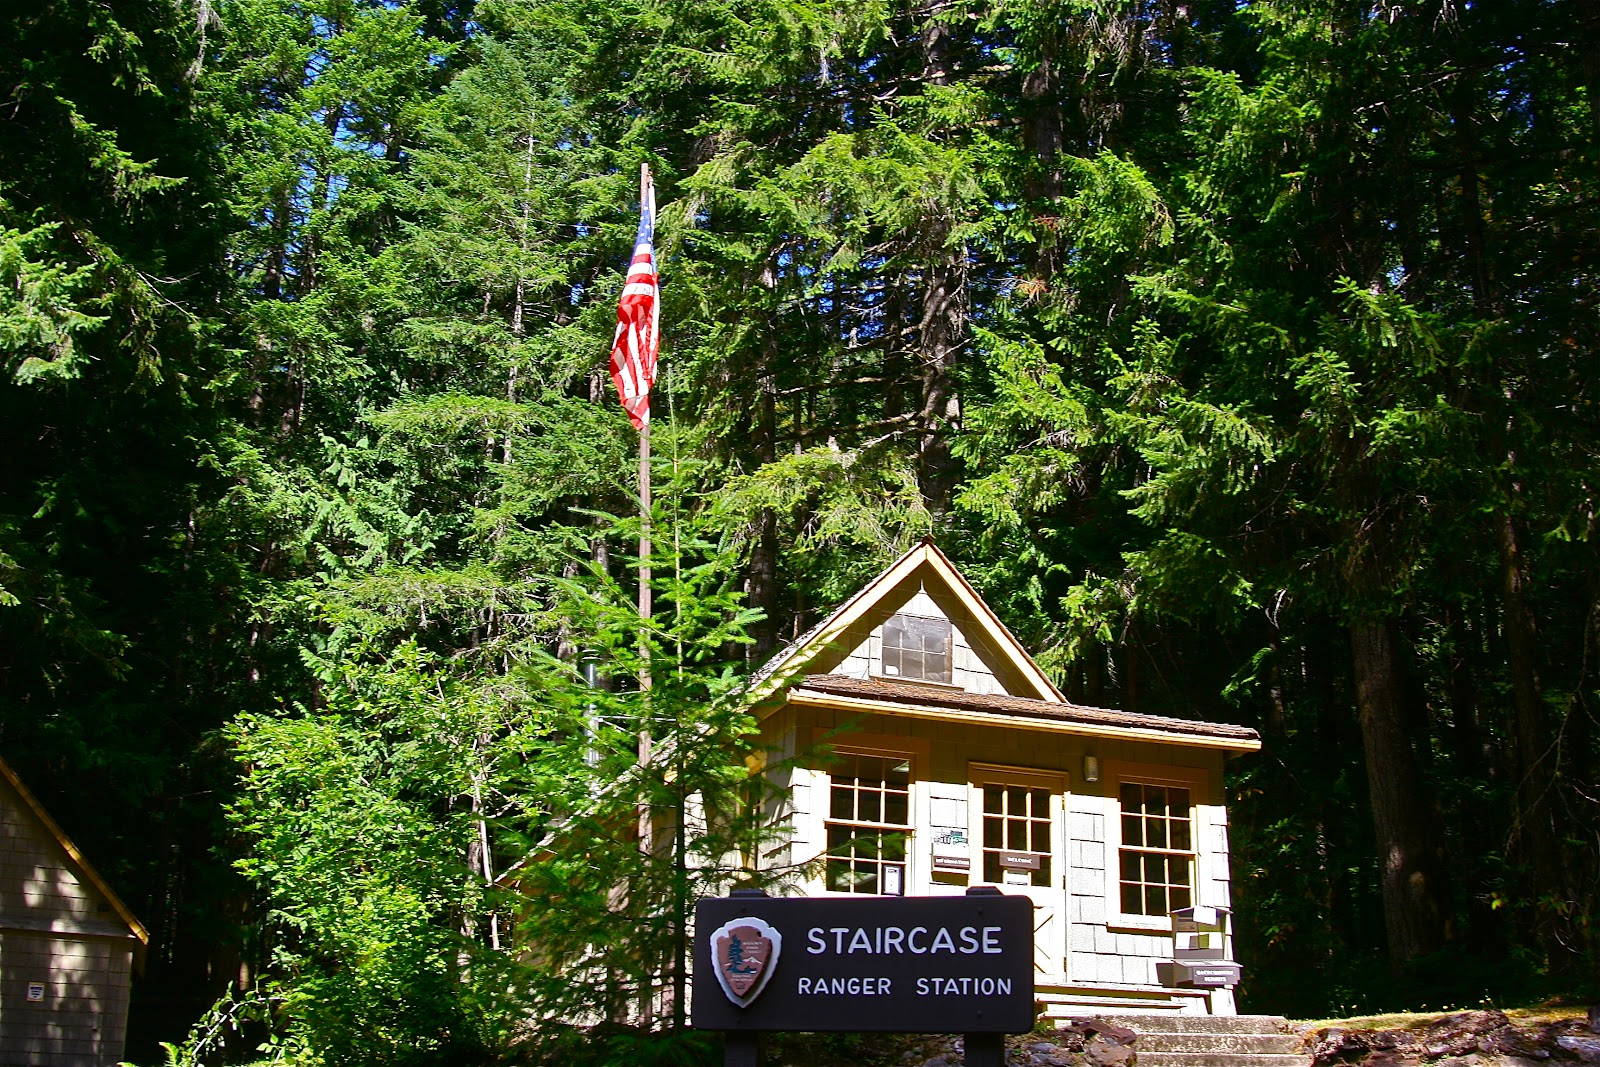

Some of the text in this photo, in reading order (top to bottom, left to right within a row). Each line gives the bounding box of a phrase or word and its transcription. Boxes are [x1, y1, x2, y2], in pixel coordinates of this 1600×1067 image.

[806, 926, 1003, 955] STAIRCASE
[798, 977, 1012, 996] RANGER STATION
